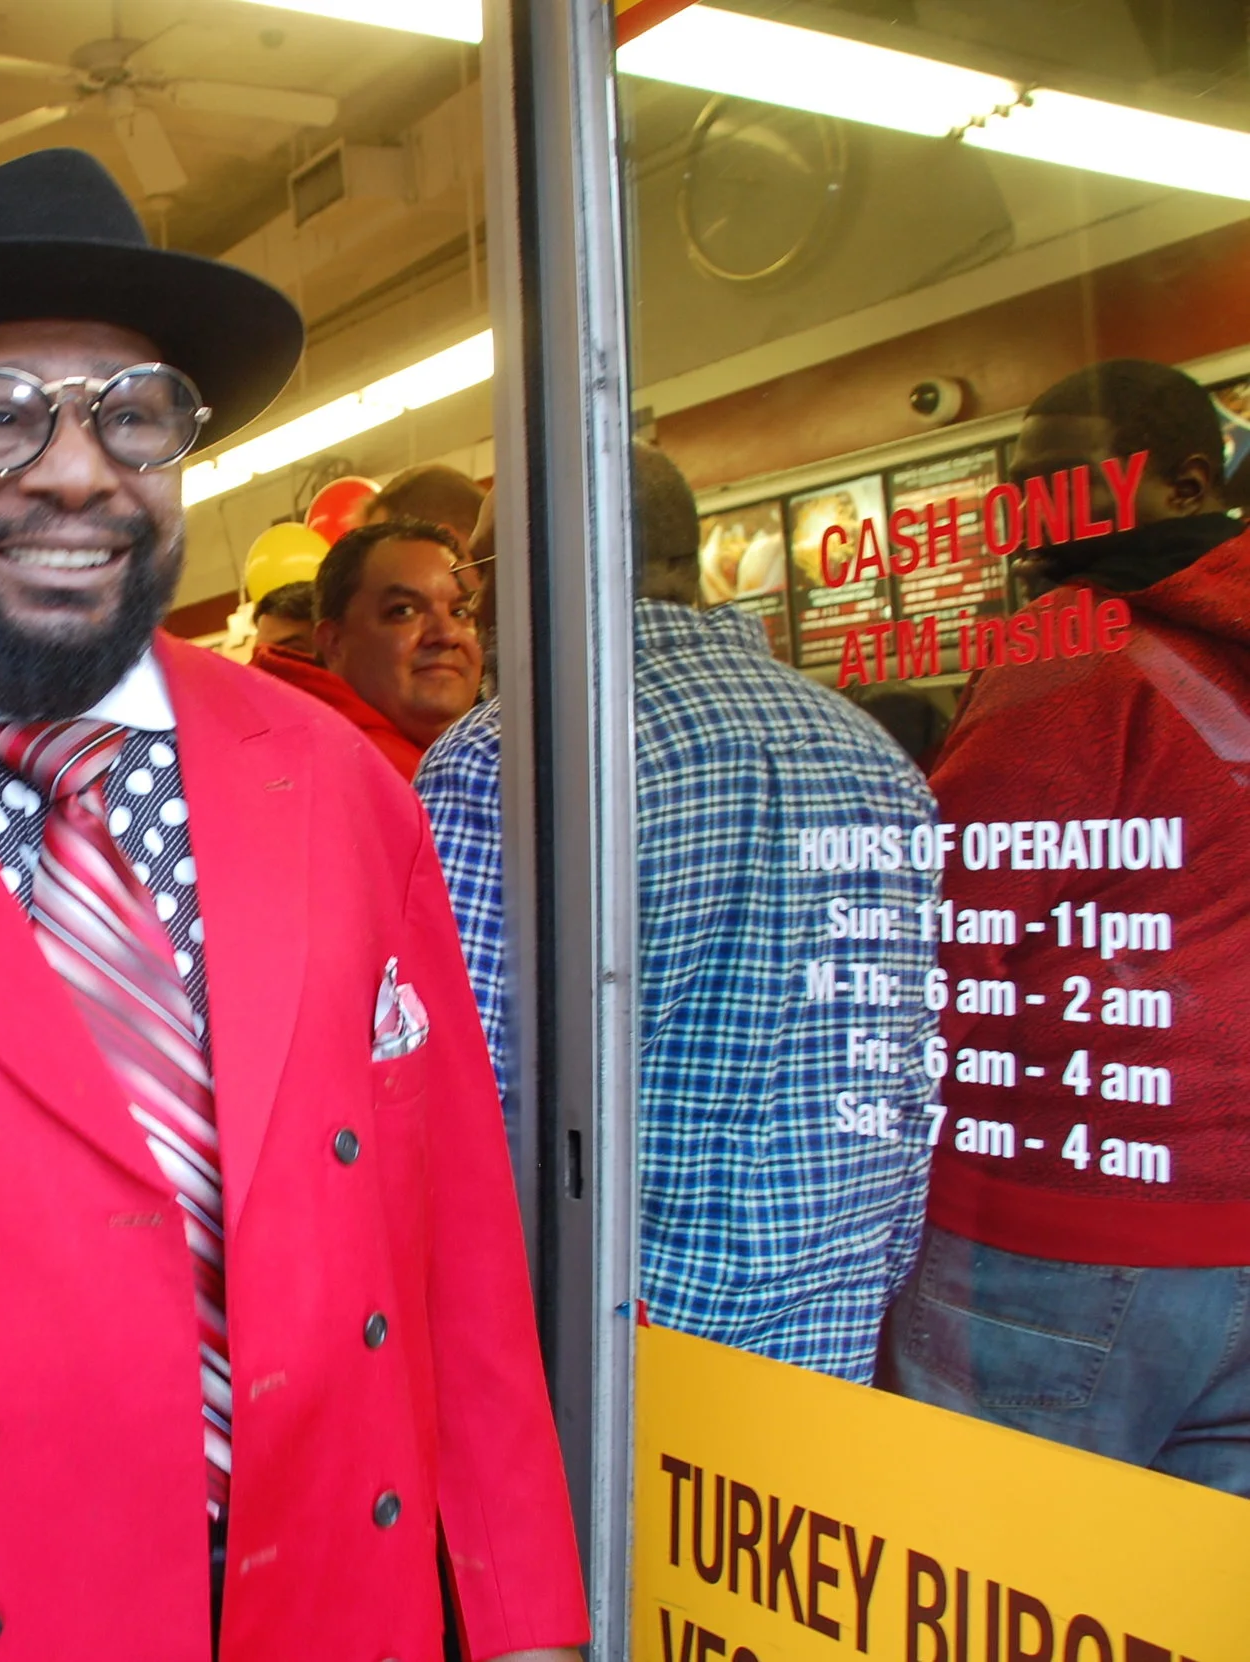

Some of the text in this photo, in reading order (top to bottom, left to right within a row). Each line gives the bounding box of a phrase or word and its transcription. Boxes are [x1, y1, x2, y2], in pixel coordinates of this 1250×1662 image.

[820, 497, 961, 588] CASH
[984, 450, 1148, 556] ONLY
[837, 614, 941, 688] ATM
[958, 589, 1131, 672] inside
[797, 816, 1183, 871] HOURS OF OPERATION
[826, 897, 901, 940] Sun:
[916, 900, 1017, 945] 11am
[1051, 901, 1172, 960] 11pm
[805, 962, 901, 1008] M-Th:
[924, 968, 949, 1011] 6
[956, 977, 1017, 1016] am
[1062, 976, 1092, 1023] 2
[1100, 986, 1172, 1029] am
[846, 1028, 901, 1074] Fri:
[924, 1036, 949, 1079] 6
[955, 1048, 1017, 1088] am
[1061, 1049, 1092, 1096] 4
[1100, 1062, 1172, 1106] am
[834, 1091, 901, 1139] Sat:
[923, 1105, 948, 1147] 7
[955, 1117, 1016, 1158] am
[1061, 1124, 1091, 1170] 4
[1100, 1137, 1171, 1183] am
[660, 1452, 885, 1655] TURKEY
[905, 1547, 1199, 1662] BUR
